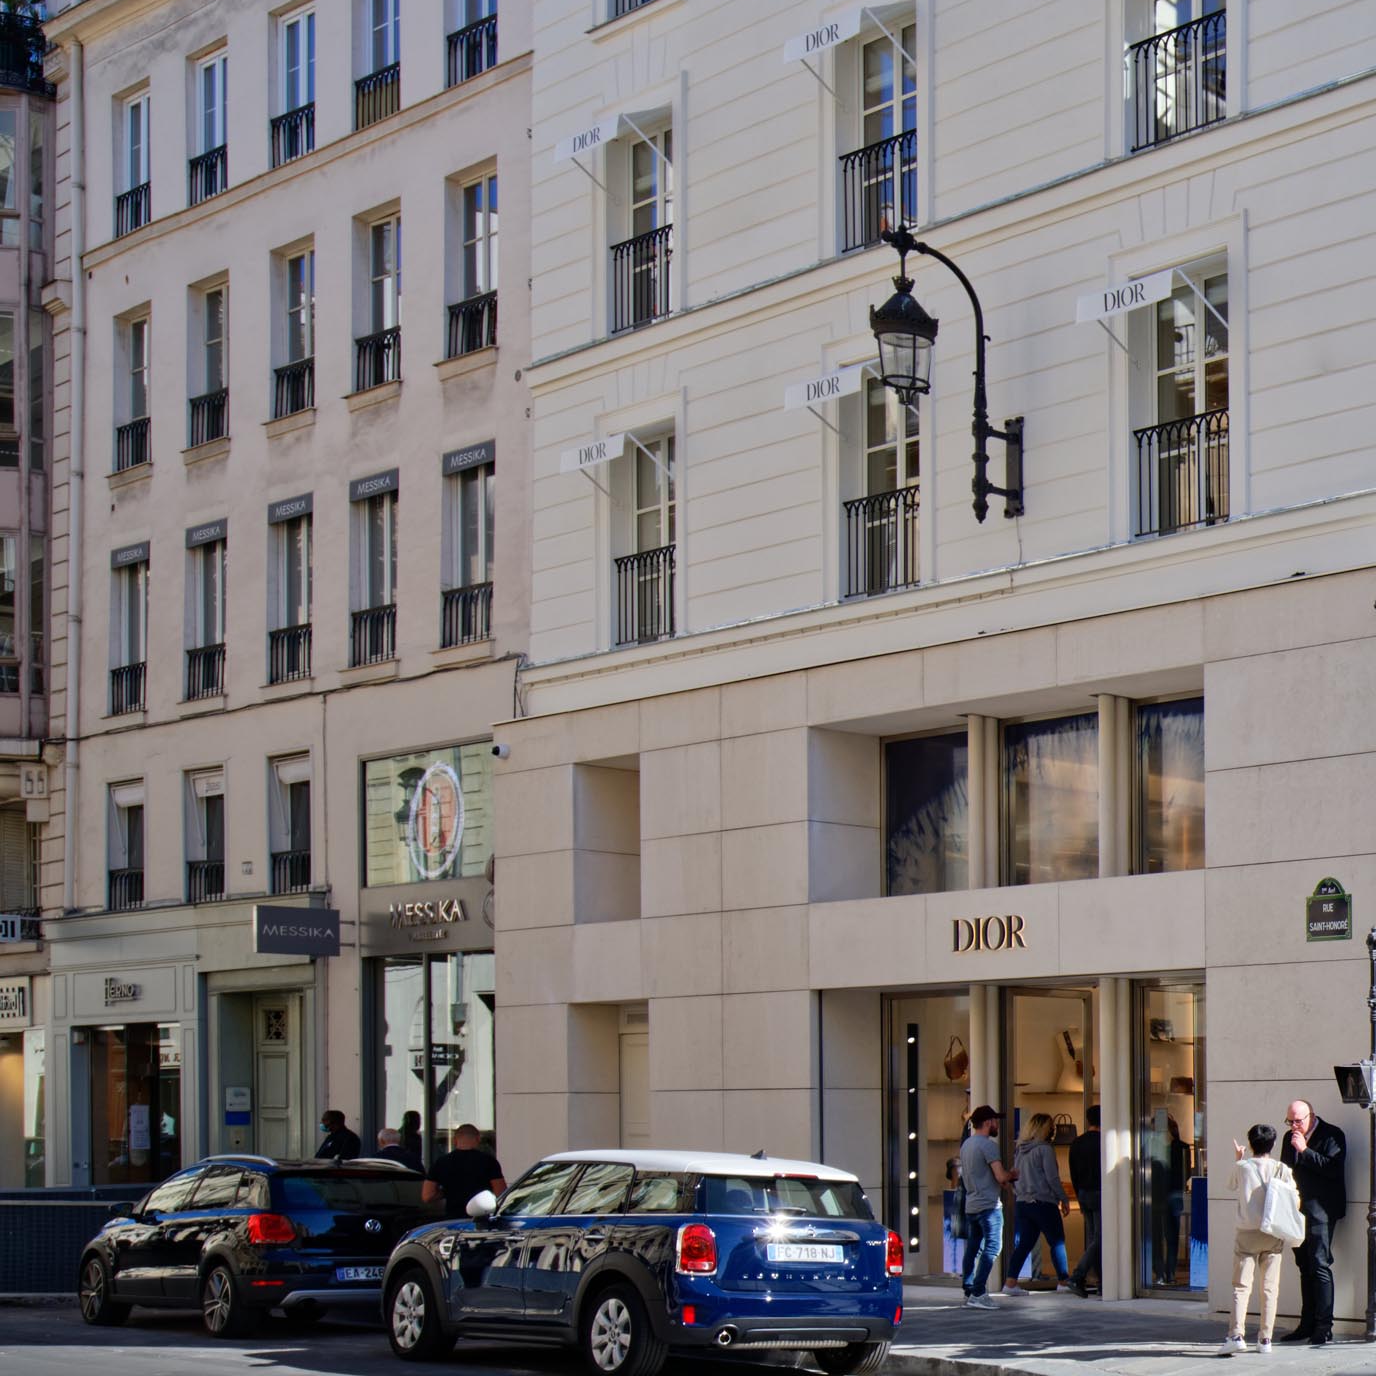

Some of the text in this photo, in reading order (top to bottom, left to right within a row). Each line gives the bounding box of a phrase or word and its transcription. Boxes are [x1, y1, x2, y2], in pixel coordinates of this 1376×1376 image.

[805, 22, 839, 51] DIOR
[573, 127, 600, 152] DIOR
[1104, 282, 1145, 311] DIOR
[807, 374, 839, 400] DIOR
[451, 448, 486, 466] MESSIKA
[579, 442, 606, 465] DIOR
[358, 476, 391, 494] MESSIKA
[275, 500, 306, 517] MESSIKA
[192, 525, 221, 541] MESSIKA
[1322, 903, 1334, 913] RUE
[262, 924, 335, 939] MESSIKA
[952, 915, 1027, 953] DIOR
[1309, 919, 1348, 931] SAINT-HONORÉ
[778, 1247, 835, 1259] FC-718-NJ
